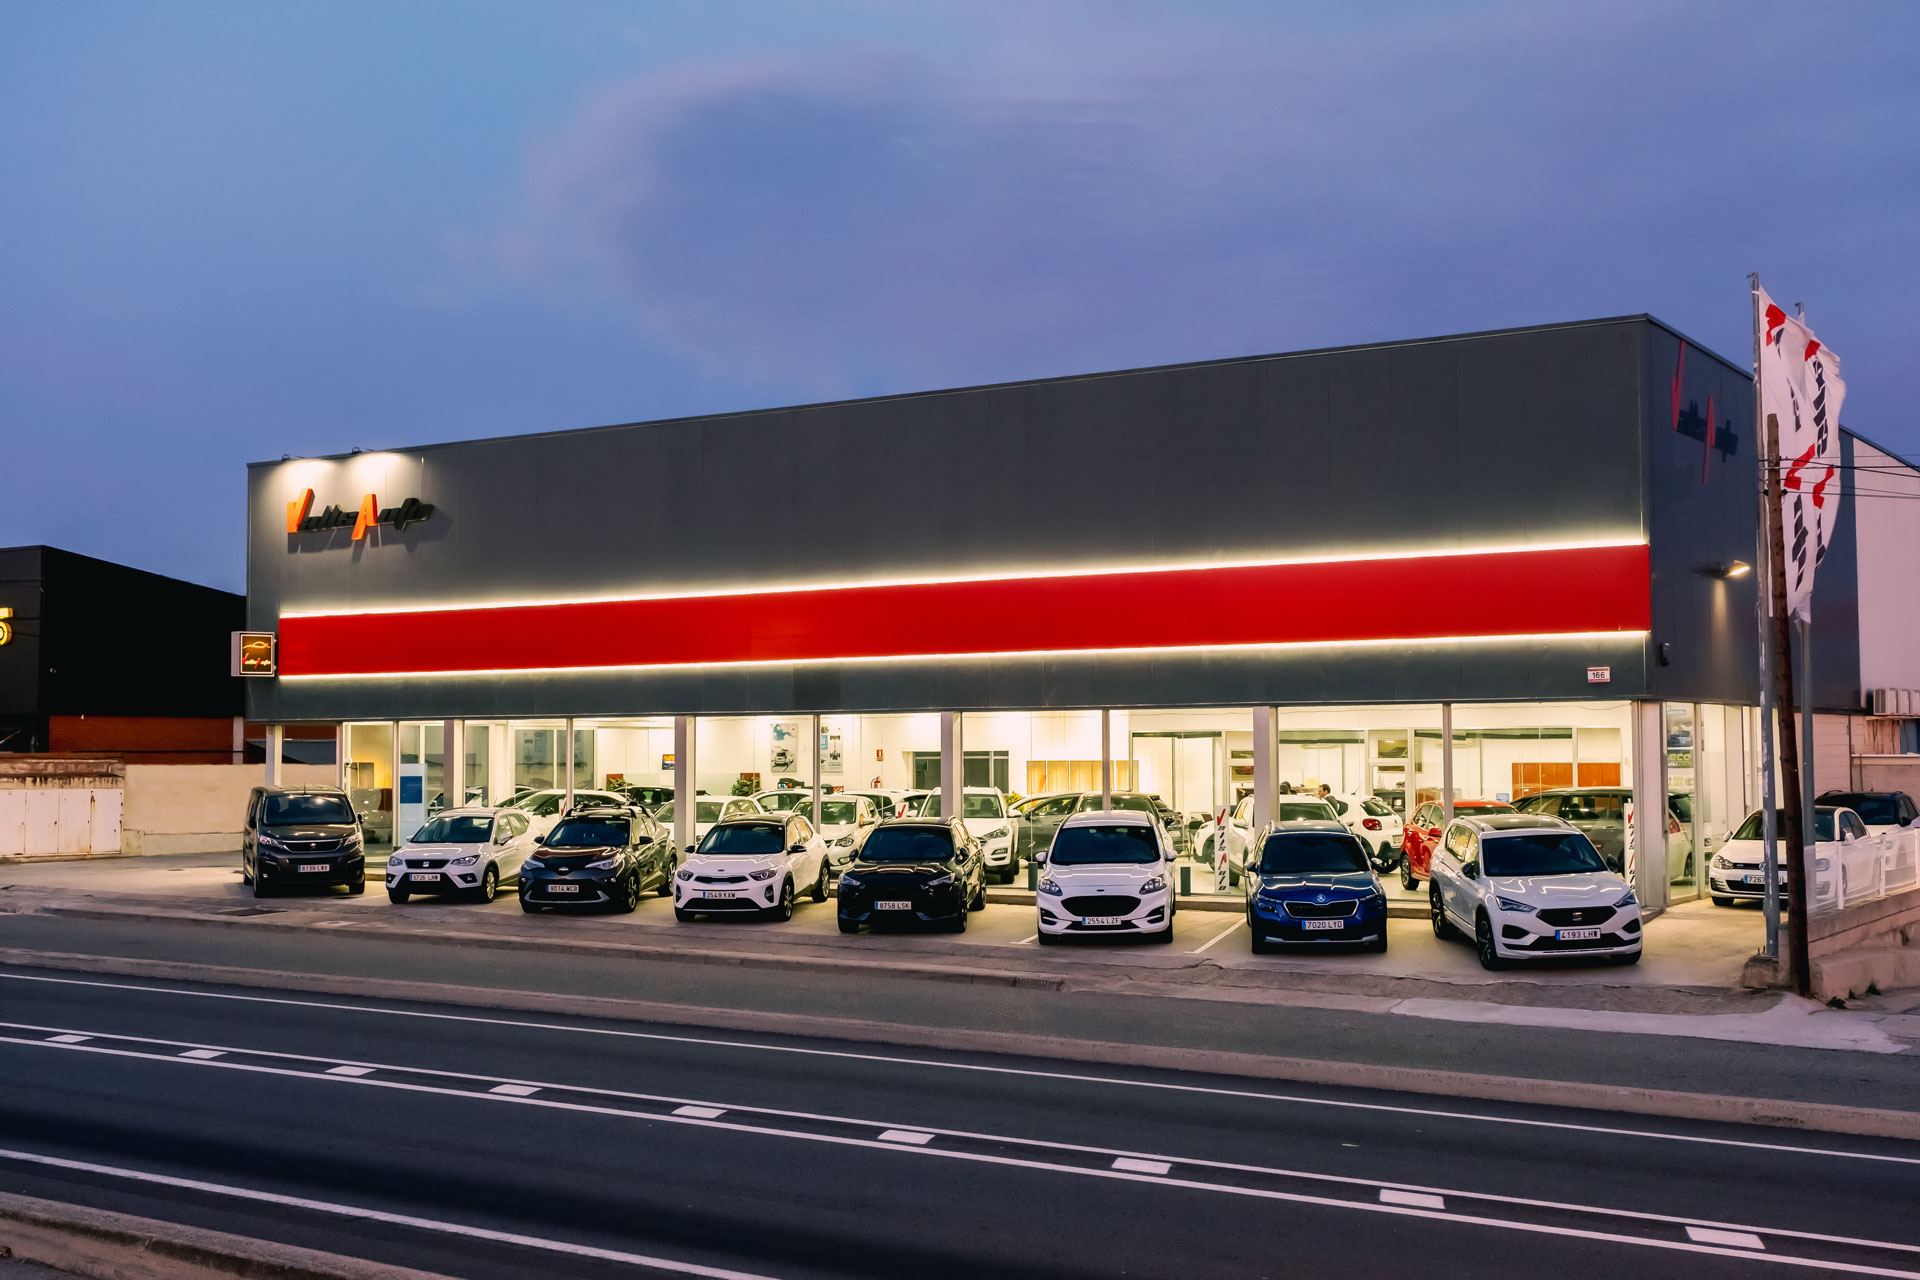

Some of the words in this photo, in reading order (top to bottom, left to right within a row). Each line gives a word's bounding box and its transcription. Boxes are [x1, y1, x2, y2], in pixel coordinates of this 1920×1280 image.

[1087, 917, 1105, 925] 2554
[1307, 921, 1327, 929] 7020
[1561, 931, 1581, 939] 4193
